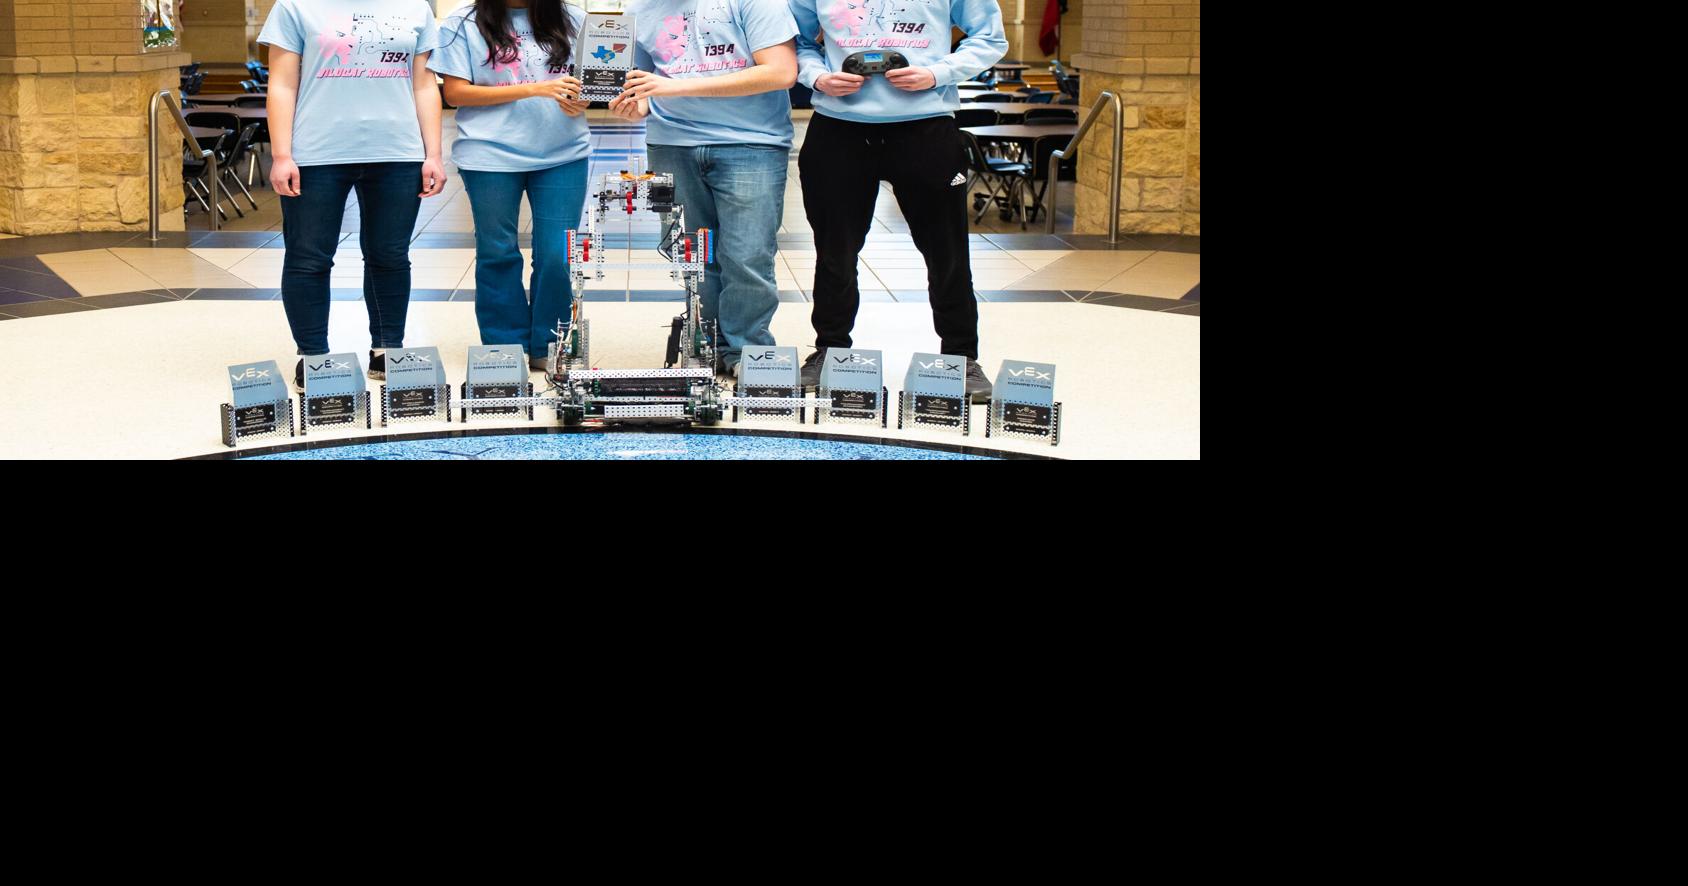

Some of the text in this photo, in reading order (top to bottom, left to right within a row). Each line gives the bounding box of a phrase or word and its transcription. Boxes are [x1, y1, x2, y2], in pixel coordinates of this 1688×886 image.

[892, 22, 926, 34] 1394
[705, 44, 735, 56] 1394
[748, 351, 790, 362] VEX
[309, 359, 350, 371] VEX
[919, 359, 960, 371] VEX
[232, 368, 270, 381] VEX
[1009, 367, 1051, 379] VEX
[232, 382, 272, 390] COMPETITION
[1008, 381, 1051, 389] COMPETITION
